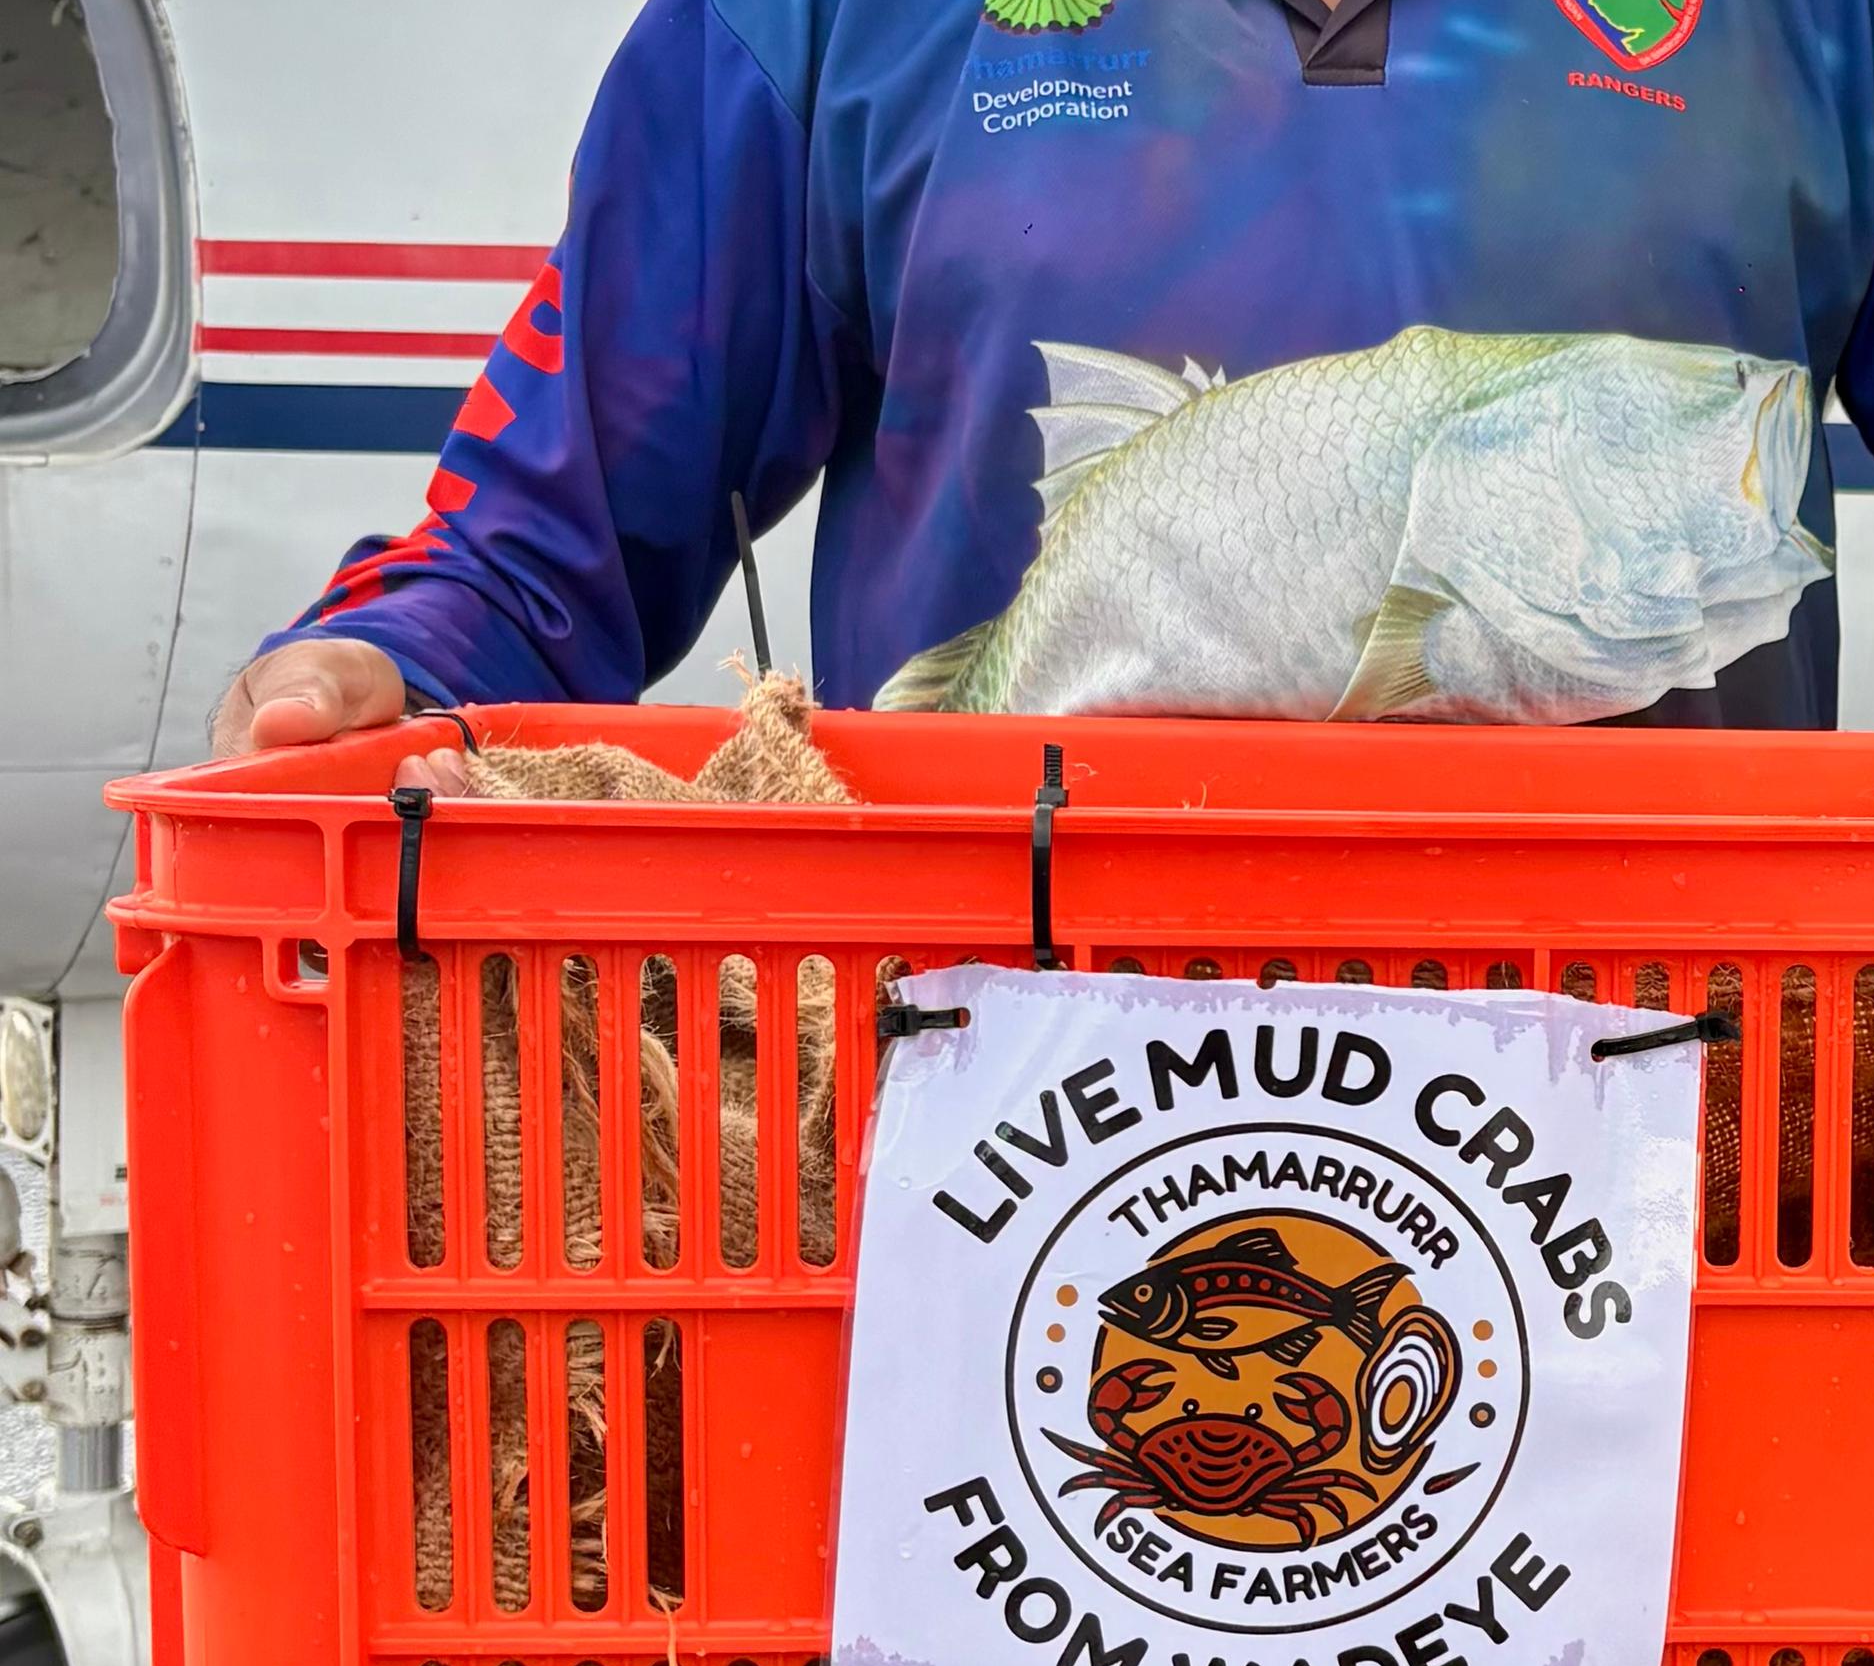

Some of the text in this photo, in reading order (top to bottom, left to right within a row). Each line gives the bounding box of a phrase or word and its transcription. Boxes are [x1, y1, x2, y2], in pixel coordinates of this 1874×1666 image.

[972, 79, 1134, 113] Development
[982, 101, 1129, 134] Corporation
[1567, 71, 1688, 113] RANGERS
[932, 1024, 1634, 1341] LIVE MUD CRABS
[1106, 1150, 1460, 1271] THAMARRURR
[1105, 1504, 1439, 1607] SEA FARMERS
